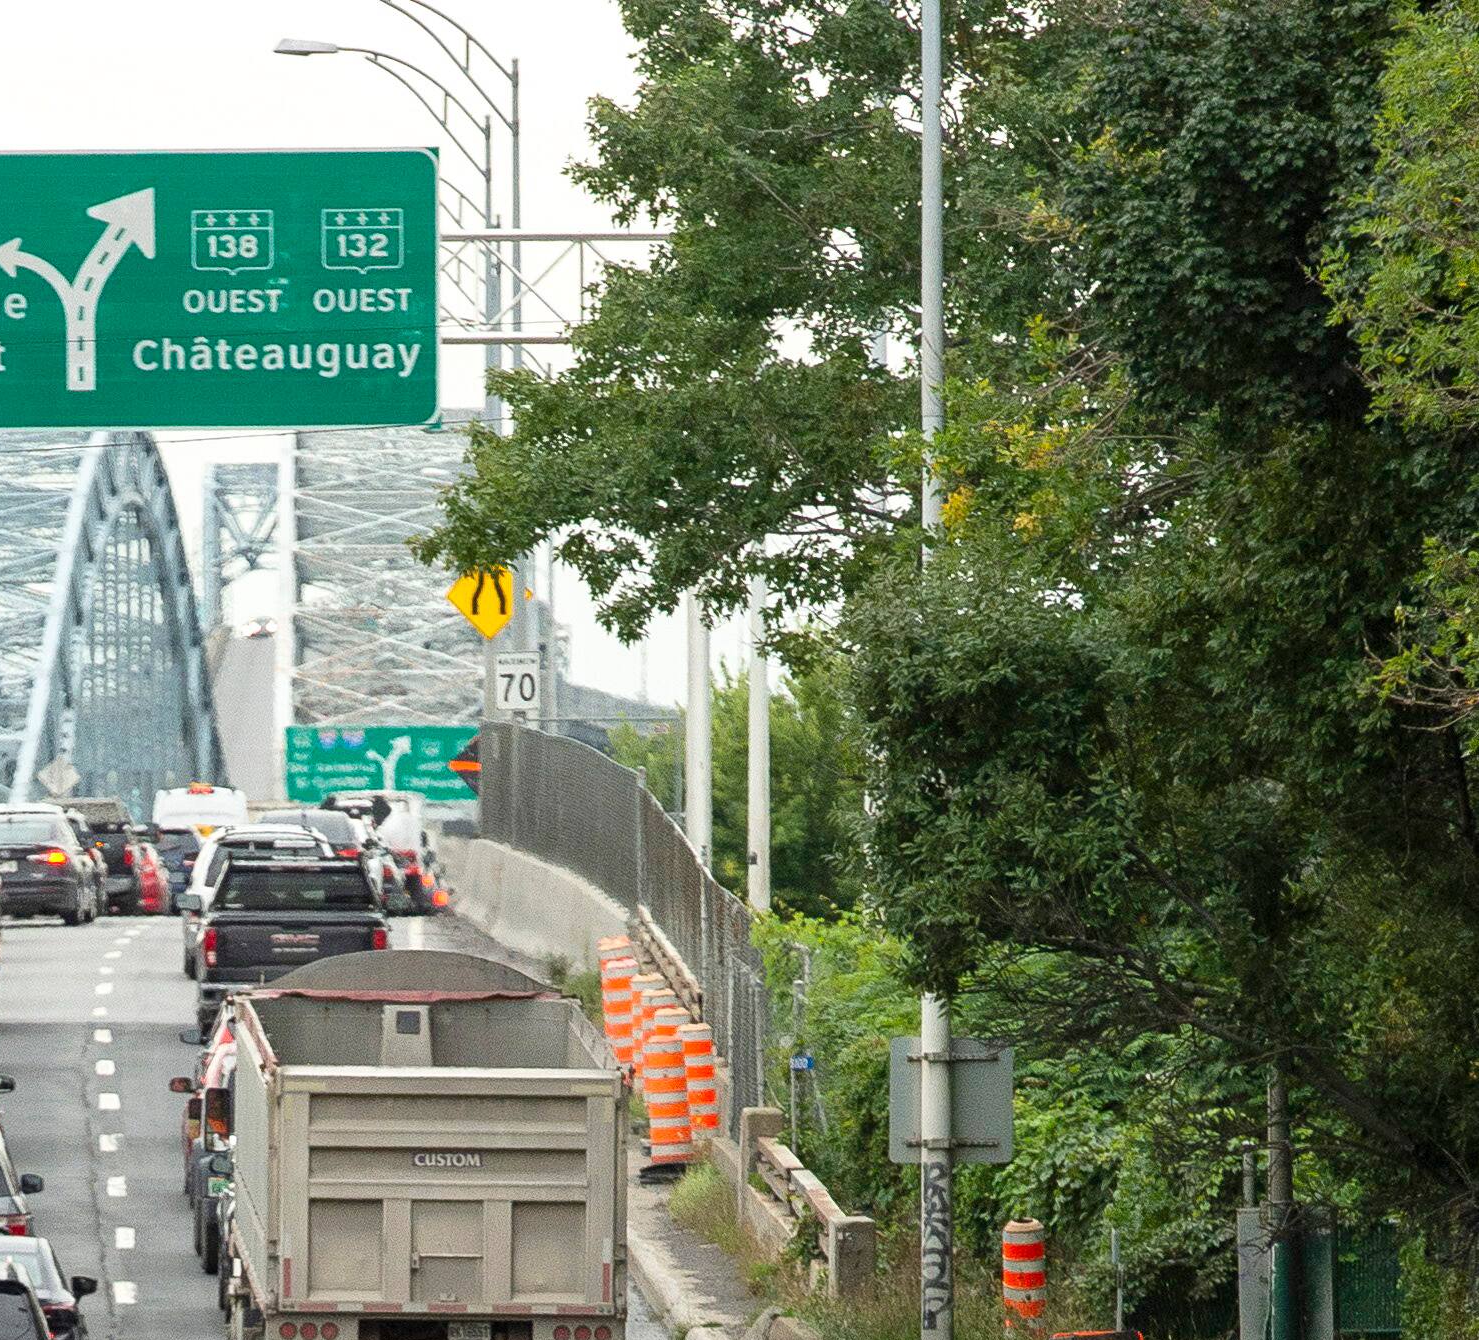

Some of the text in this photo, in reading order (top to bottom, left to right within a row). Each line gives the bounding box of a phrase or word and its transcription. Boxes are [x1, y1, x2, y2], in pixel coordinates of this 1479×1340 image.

[207, 234, 259, 258] 138
[336, 233, 389, 258] 132
[182, 288, 282, 313] OUEST
[312, 288, 412, 312] OUEST
[132, 336, 421, 378] Châteauguay
[500, 673, 535, 702] 70
[414, 1153, 480, 1167] CUSTOM
